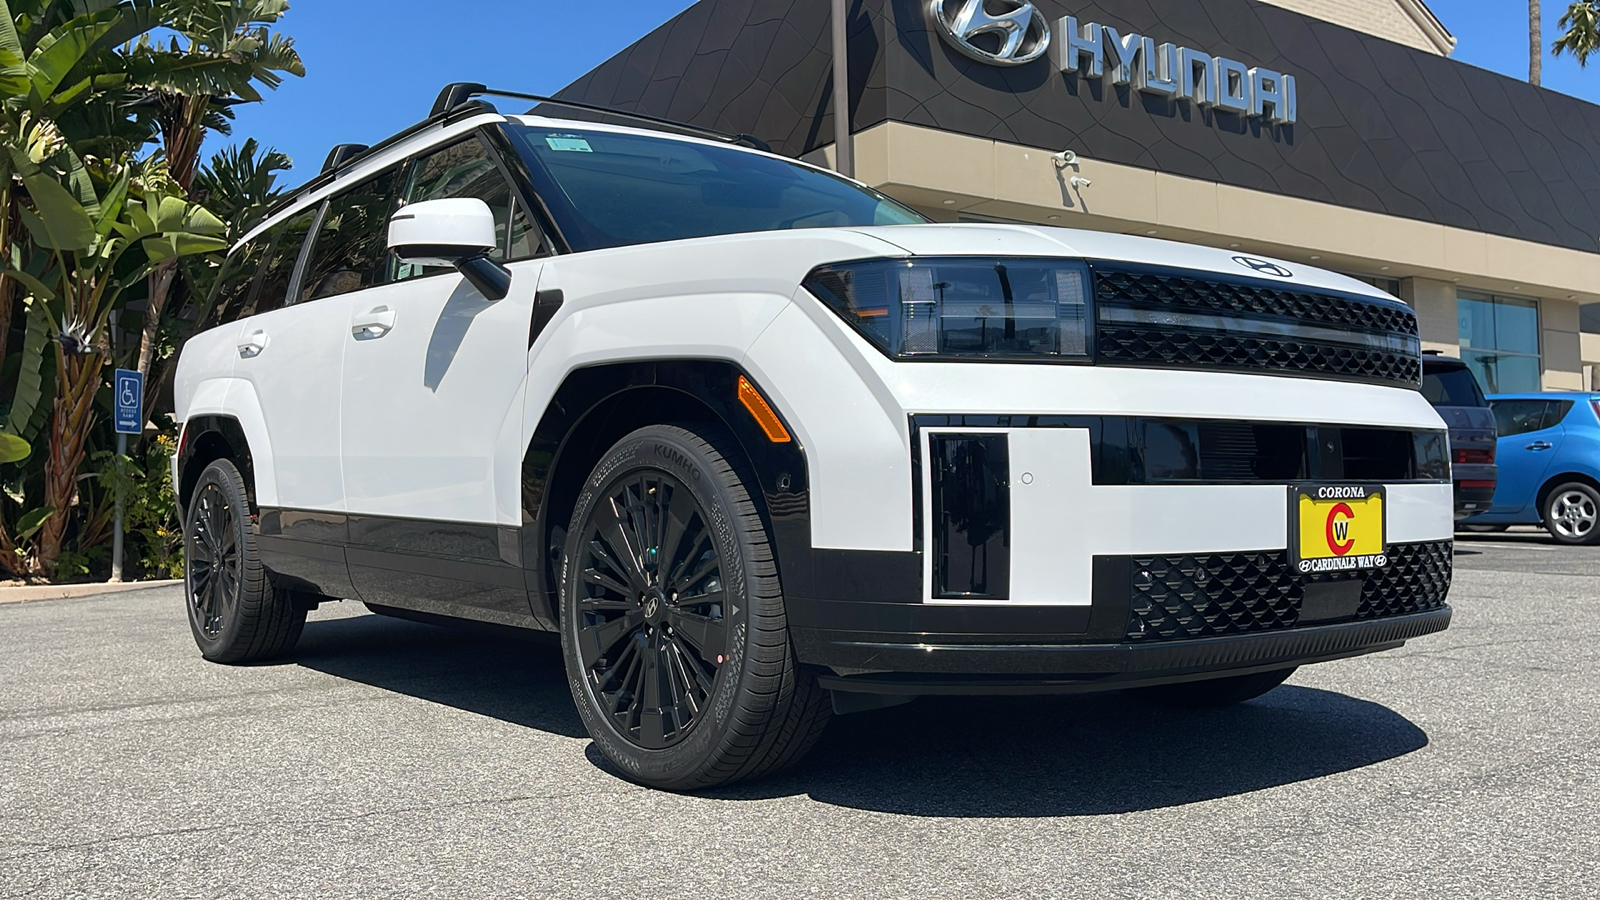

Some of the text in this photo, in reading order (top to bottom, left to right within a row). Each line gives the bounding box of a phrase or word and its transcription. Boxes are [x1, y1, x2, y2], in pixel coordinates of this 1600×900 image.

[1058, 15, 1297, 125] HYUNDAI
[653, 443, 701, 481] KUMHO
[1318, 487, 1365, 498] CORONA
[1312, 555, 1375, 571] CARDINALE WAY
